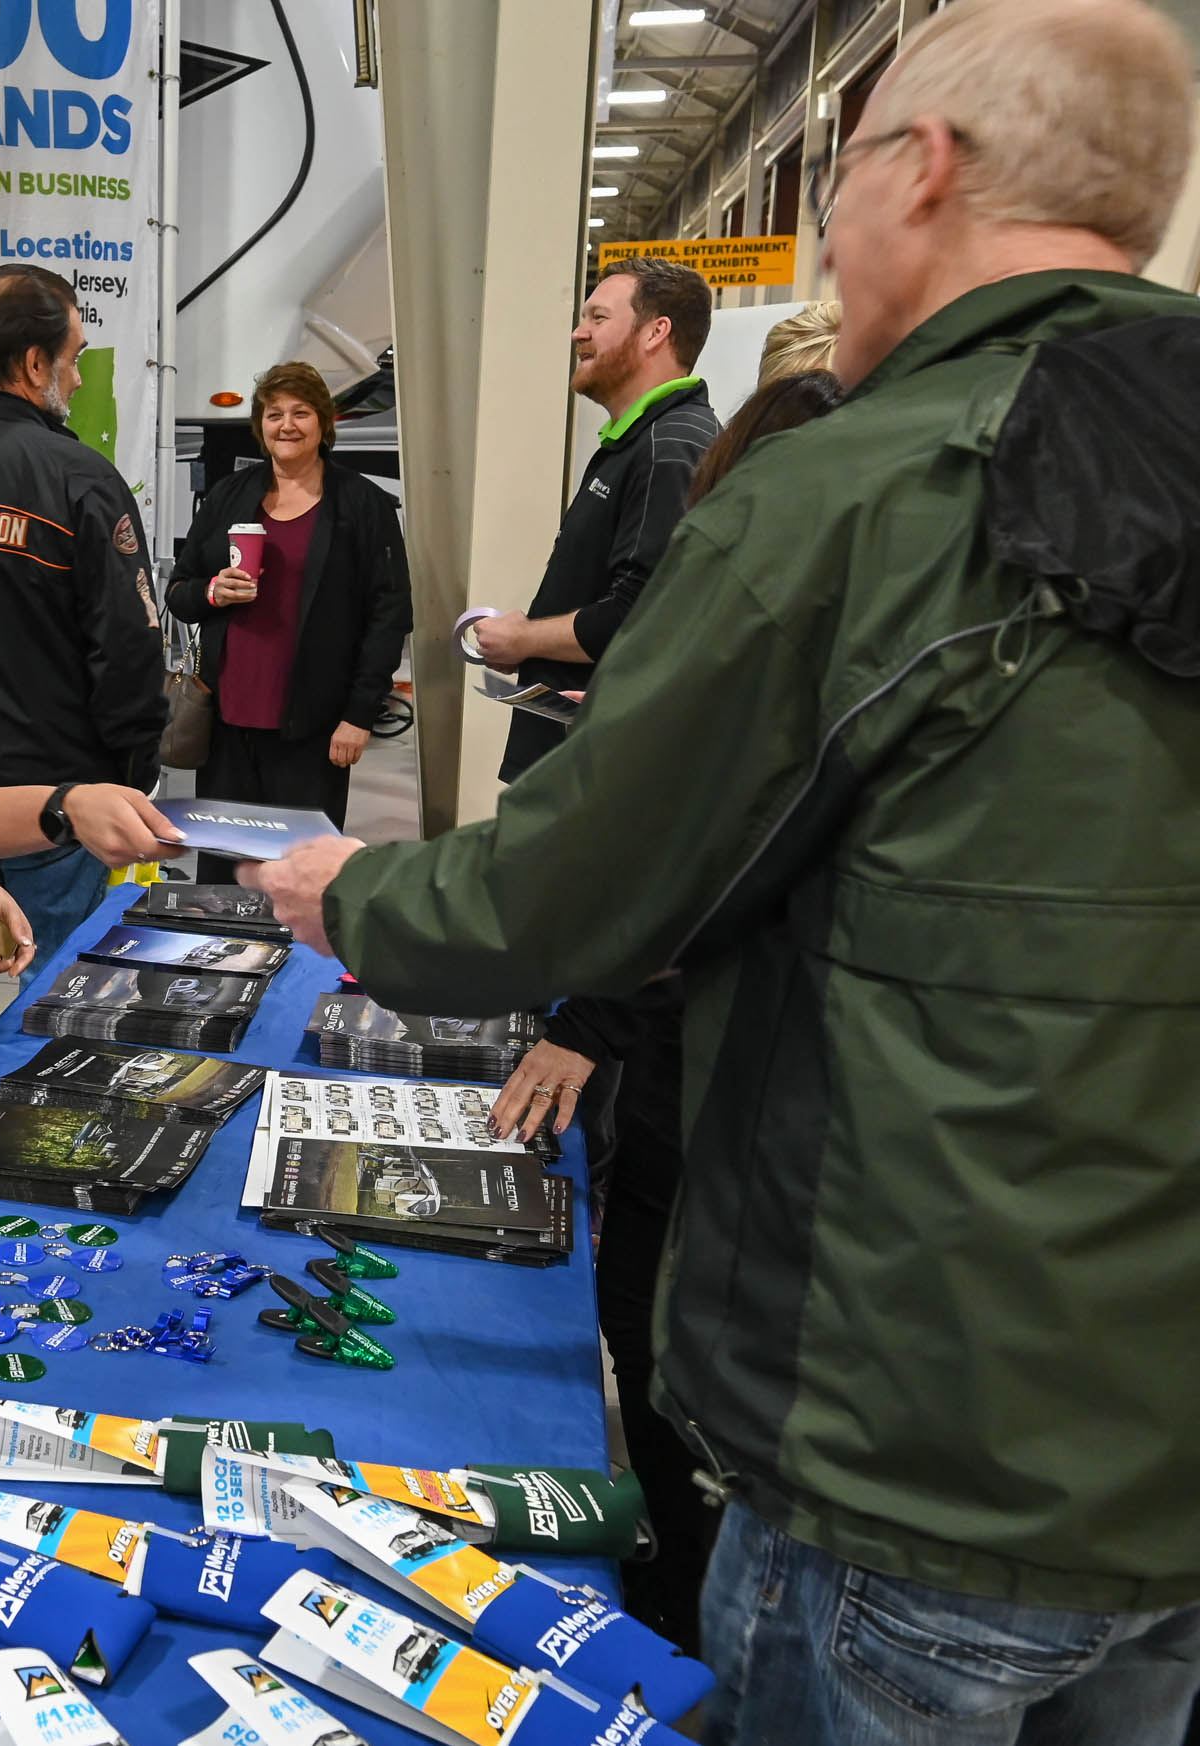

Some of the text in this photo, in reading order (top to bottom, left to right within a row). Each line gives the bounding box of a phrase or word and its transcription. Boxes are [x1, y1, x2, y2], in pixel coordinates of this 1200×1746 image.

[19, 172, 131, 200] BUSINESS
[0, 229, 133, 262] Locations
[604, 247, 639, 259] PRIZE
[644, 246, 680, 257] AREA,
[702, 256, 760, 269] EXHIBITS
[709, 273, 757, 284] AHEAD
[187, 812, 289, 831] IMAGINE
[502, 1165, 519, 1211] REFLECTION
[260, 1467, 272, 1531] Pennsylvania
[216, 1505, 230, 1521] 12
[230, 1505, 245, 1521] TO
[18, 1585, 33, 1600] RV
[464, 1579, 498, 1608] OVER
[345, 1603, 385, 1647] #1 RV
[576, 1630, 590, 1645] RV
[35, 1702, 95, 1728] #1 RV
[270, 1703, 291, 1721] #1
[484, 1683, 521, 1731] OVER
[41, 1727, 63, 1743] IN
[222, 1724, 244, 1741] 12
